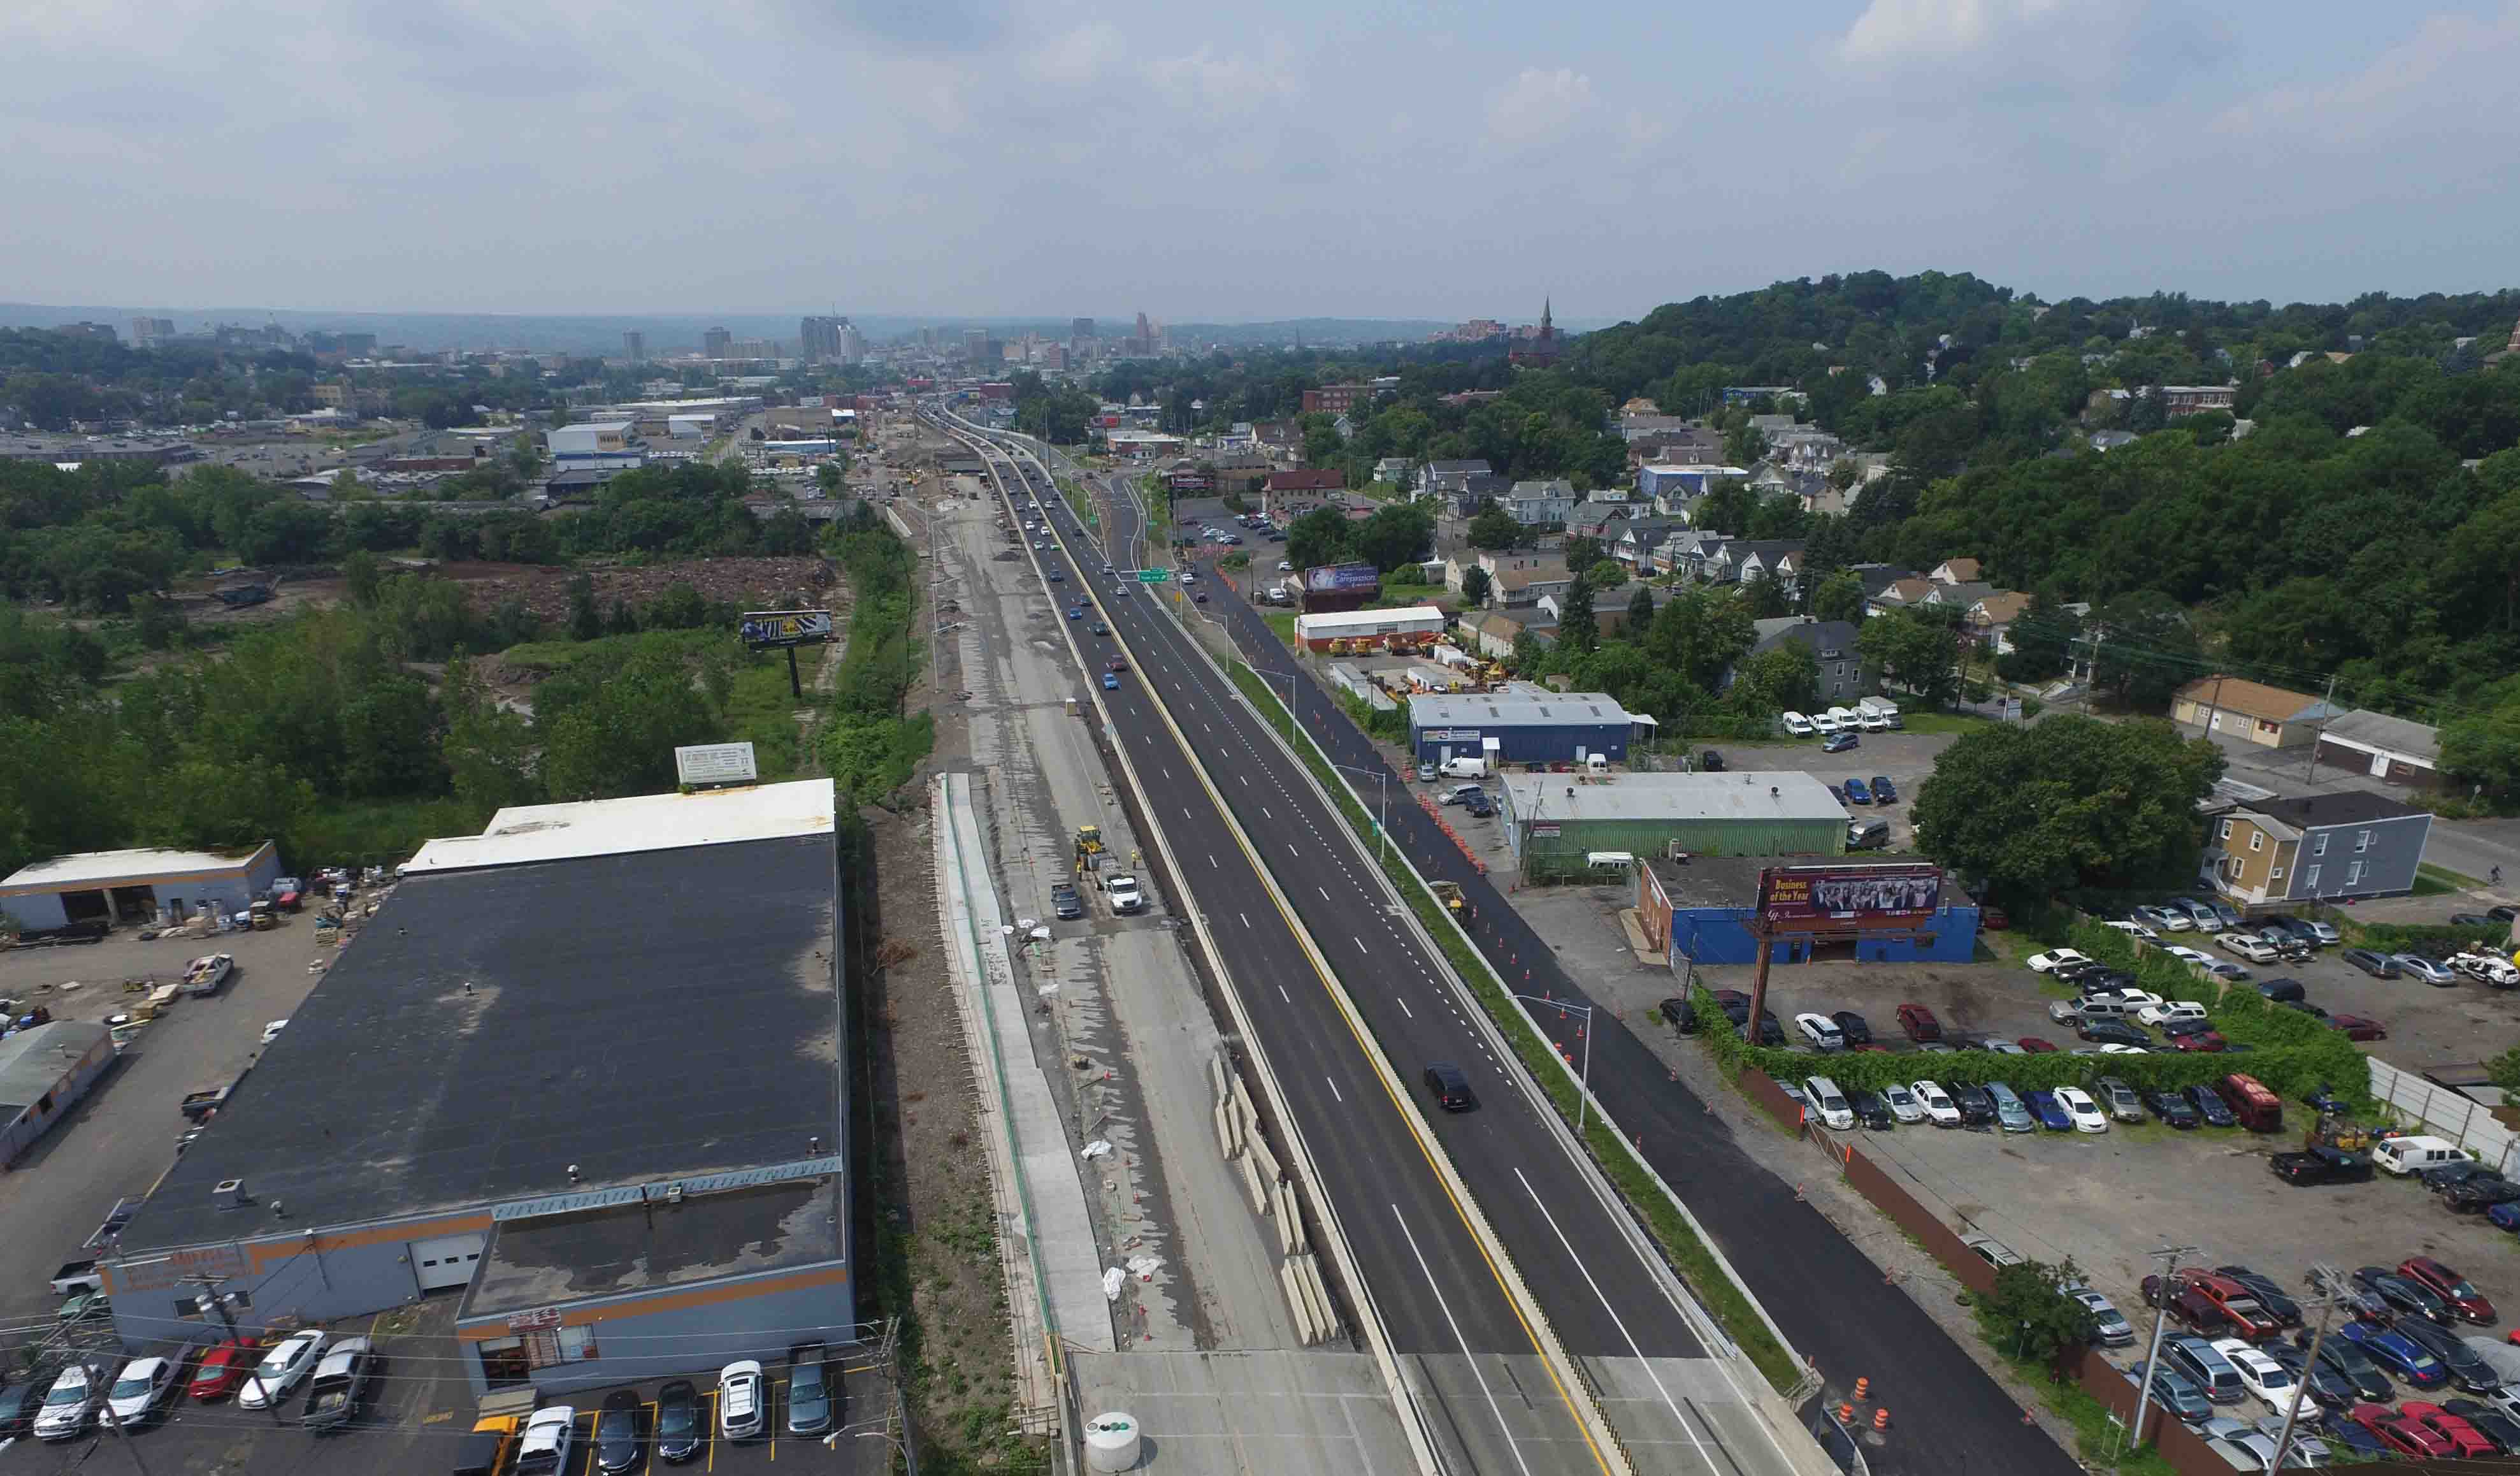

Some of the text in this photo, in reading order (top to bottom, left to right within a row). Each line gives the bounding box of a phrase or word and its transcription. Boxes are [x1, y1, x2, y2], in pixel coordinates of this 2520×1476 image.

[1775, 879, 1807, 890] Business
[1769, 890, 1810, 901] of the Year
